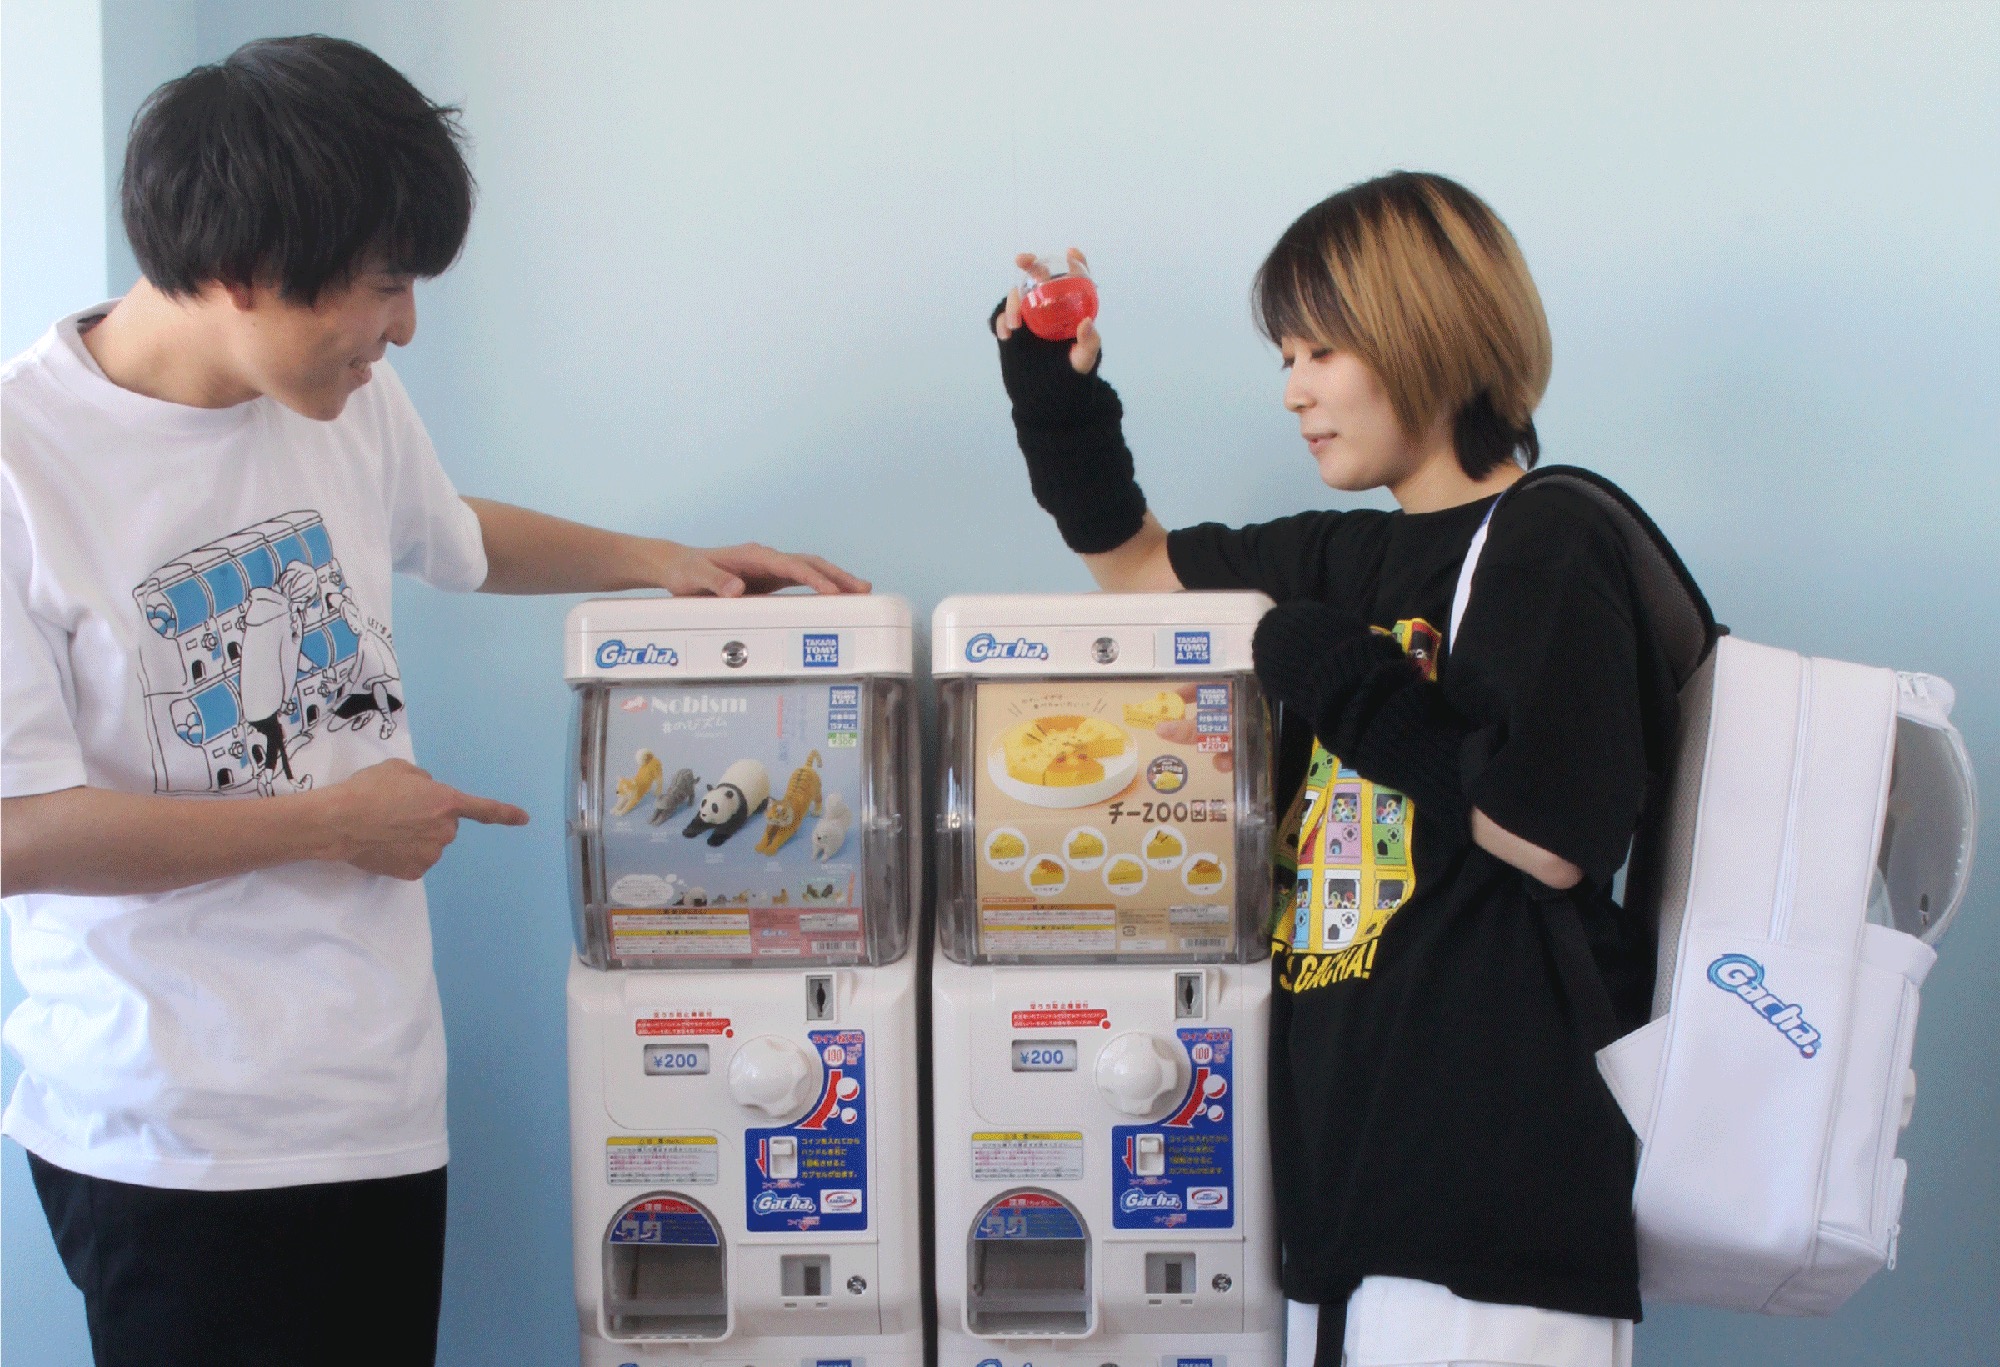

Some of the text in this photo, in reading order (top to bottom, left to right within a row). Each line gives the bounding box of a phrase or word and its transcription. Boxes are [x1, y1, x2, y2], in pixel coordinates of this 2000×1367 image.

[805, 646, 837, 654] TOMY
[1177, 643, 1207, 651] TOMY
[653, 1053, 698, 1068] ¥200
[827, 1048, 843, 1063] 100
[1020, 1049, 1064, 1064] ¥200
[1195, 1047, 1210, 1060] 100
